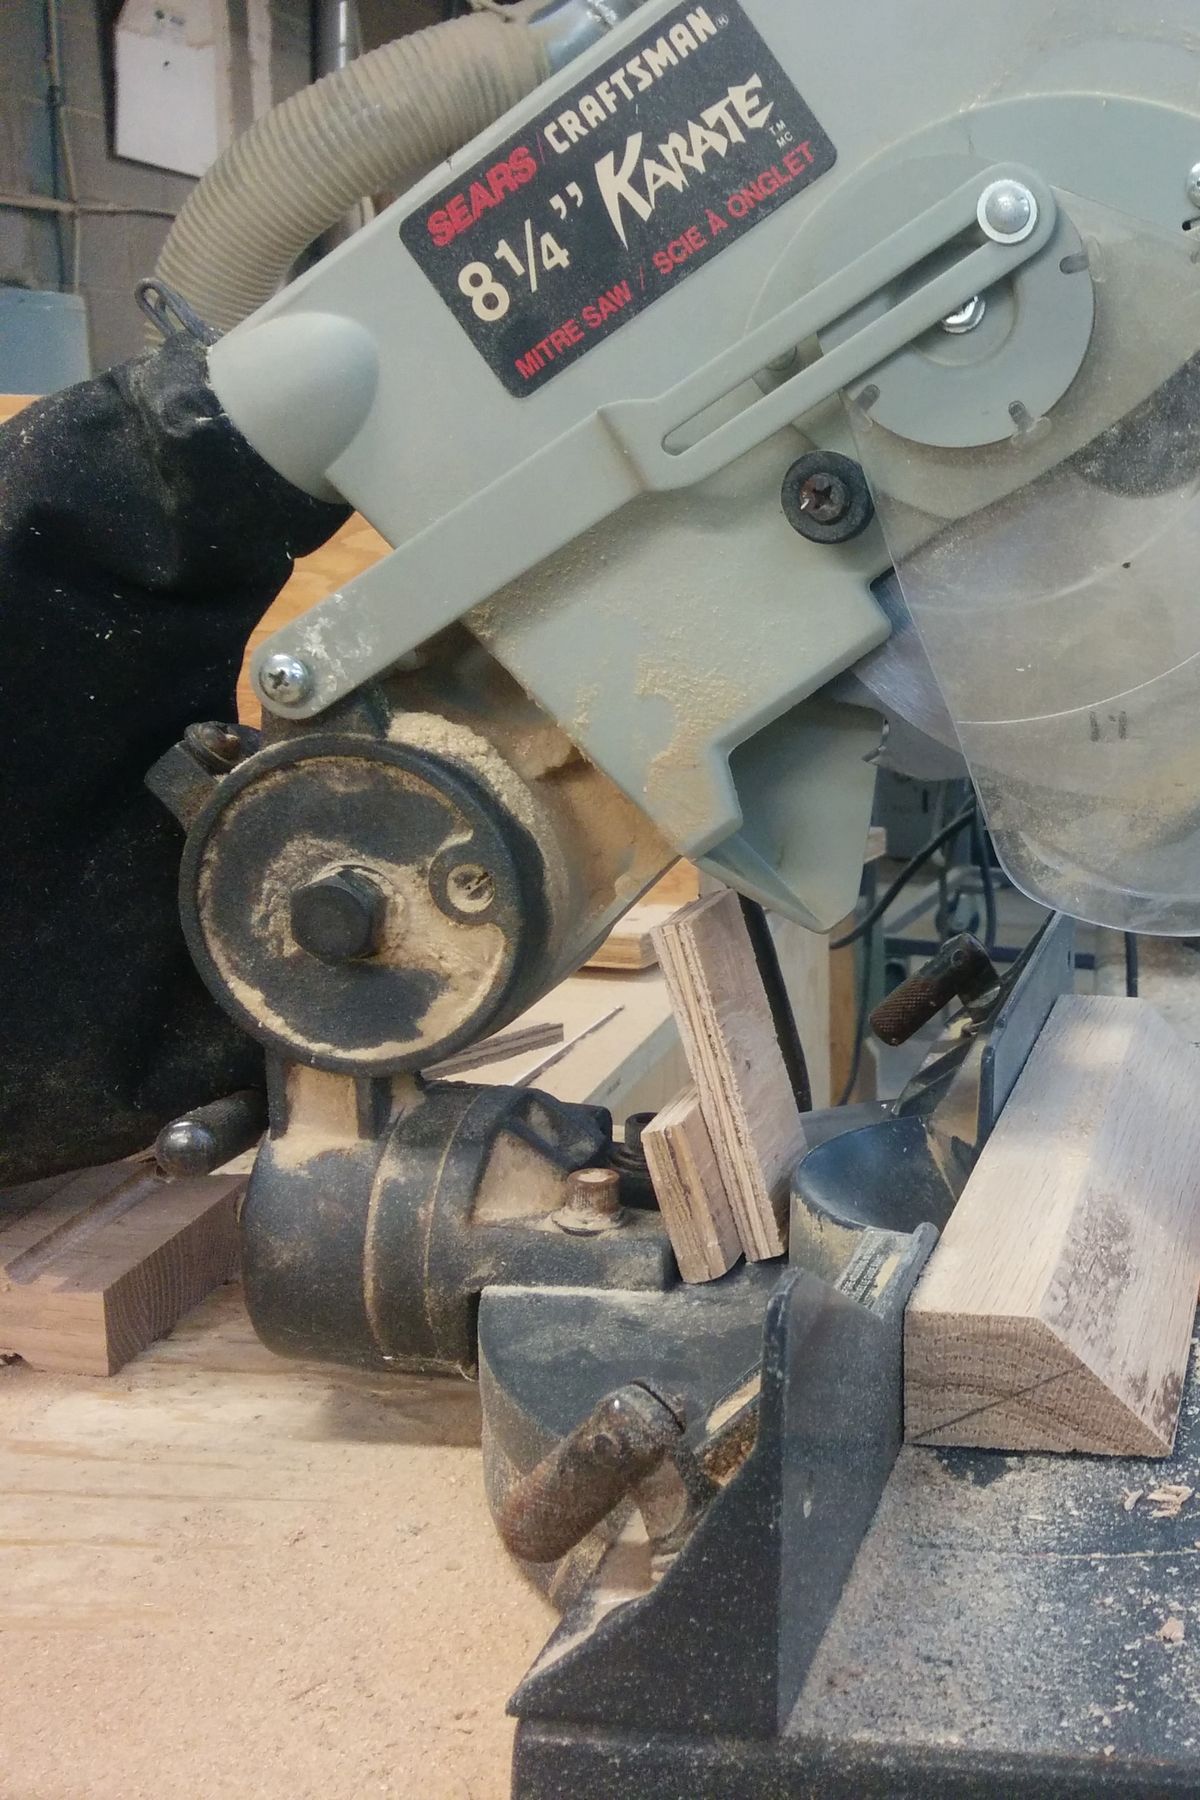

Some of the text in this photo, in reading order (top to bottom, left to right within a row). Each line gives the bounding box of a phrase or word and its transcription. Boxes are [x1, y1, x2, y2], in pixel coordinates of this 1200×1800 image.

[427, 146, 537, 248] SEARS
[544, 6, 718, 155] CRAFTSMAN
[594, 73, 774, 251] KARATE
[514, 319, 585, 380] MITRE
[582, 279, 632, 328] SAW
[652, 224, 708, 276] SCIE
[708, 209, 728, 234] À
[726, 140, 816, 220] ONGLET
